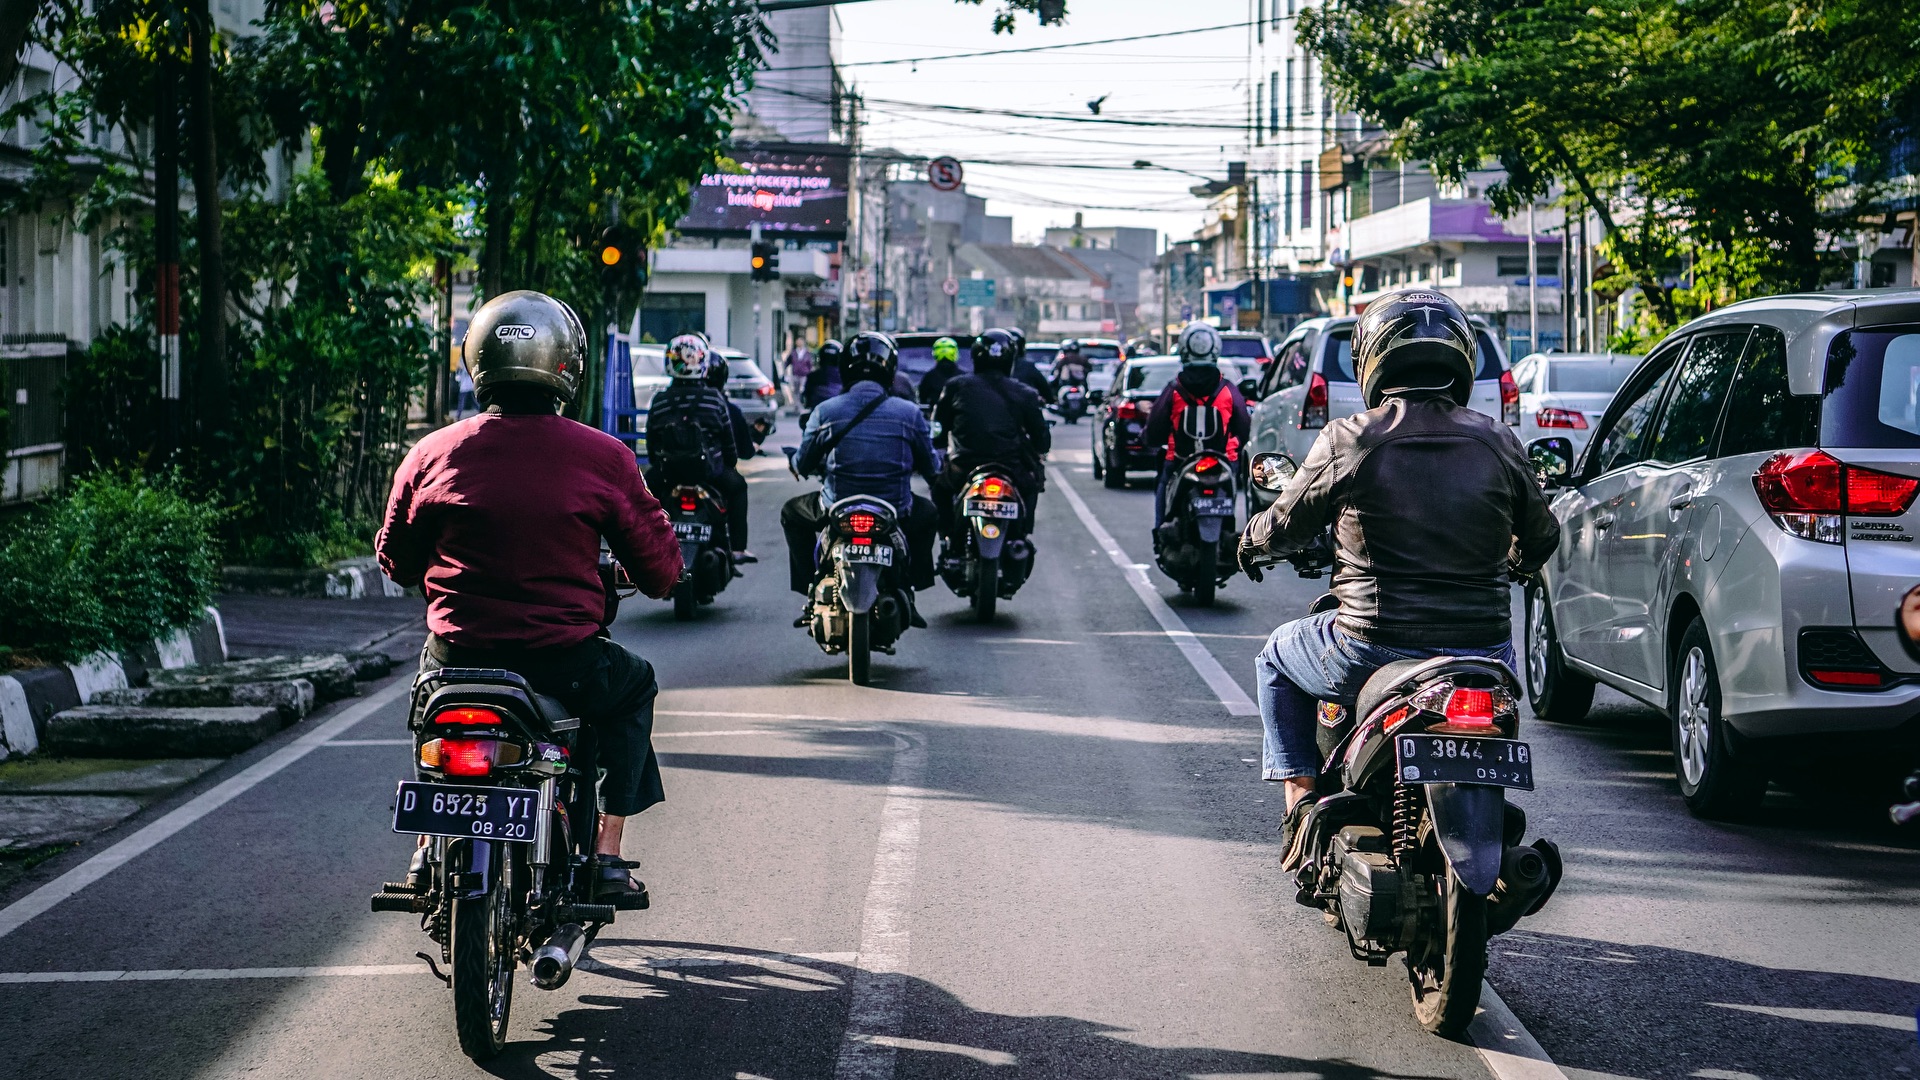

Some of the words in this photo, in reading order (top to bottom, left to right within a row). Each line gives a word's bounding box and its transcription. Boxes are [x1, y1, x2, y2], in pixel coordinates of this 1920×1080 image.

[722, 174, 754, 187] YOUR
[756, 175, 800, 189] TICKETS
[801, 176, 831, 189] NOW
[499, 326, 532, 337] BMC
[1850, 521, 1905, 532] HONDA
[1850, 532, 1915, 543] MOBILIO
[1402, 738, 1416, 759] D
[403, 790, 417, 812] D
[431, 792, 489, 816] 6525
[506, 796, 531, 819] YI
